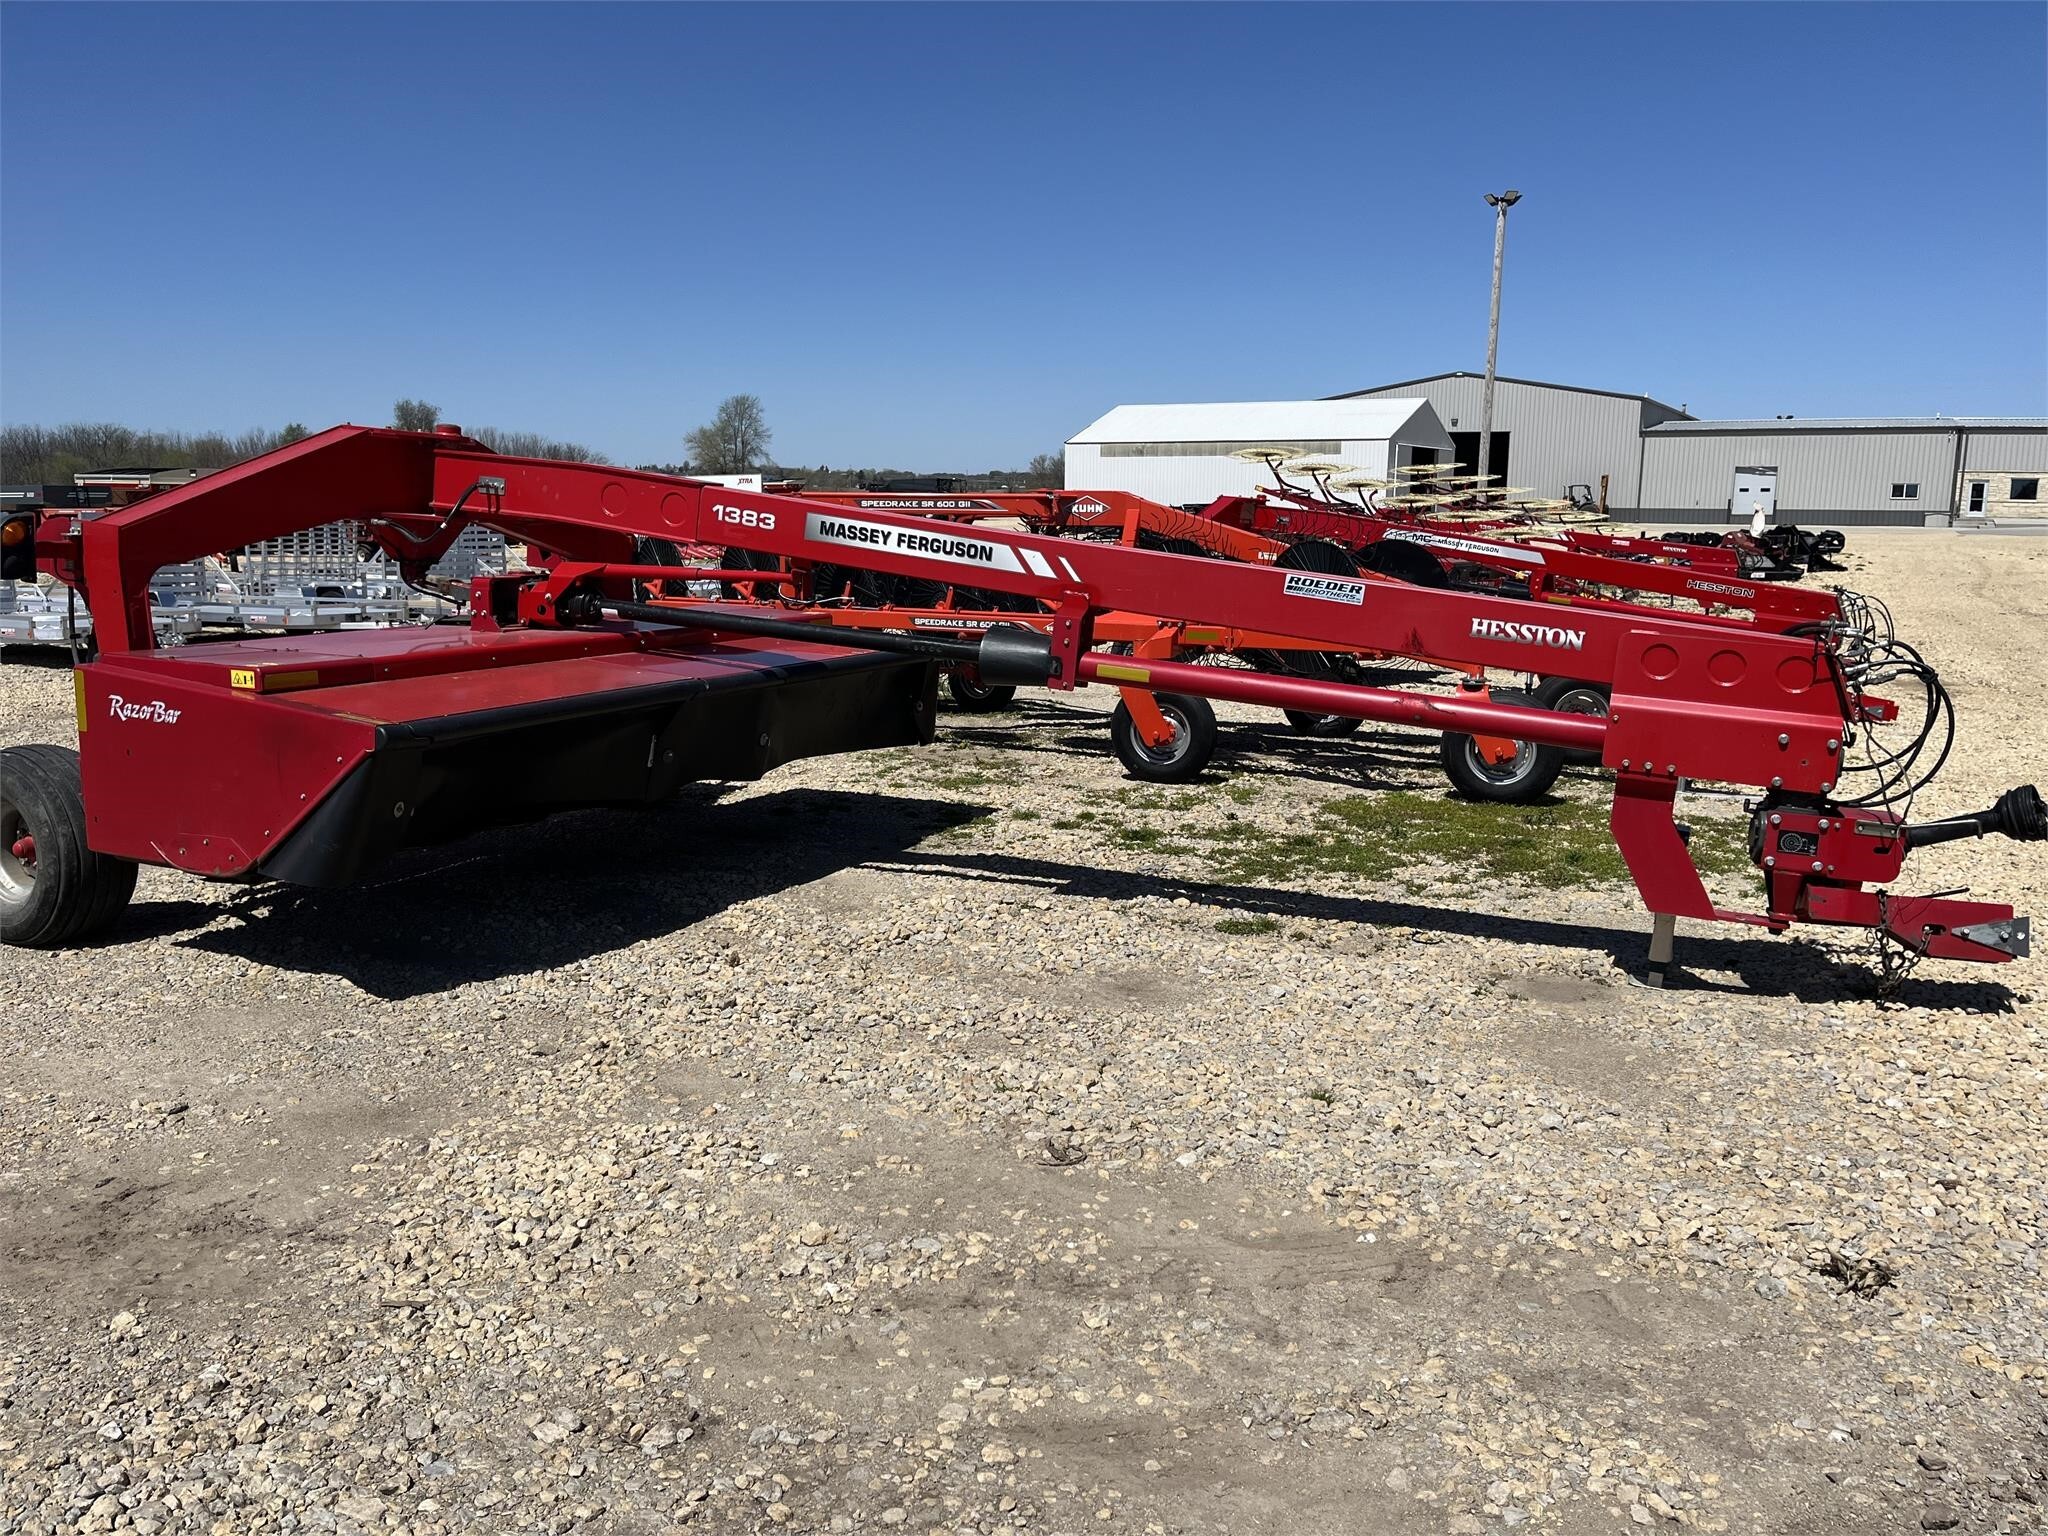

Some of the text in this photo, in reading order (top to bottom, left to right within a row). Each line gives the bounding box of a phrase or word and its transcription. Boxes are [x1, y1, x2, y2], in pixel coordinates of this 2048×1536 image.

[861, 500, 919, 508] SPEEDRAKE
[1071, 504, 1103, 513] KUHN
[712, 504, 776, 530] 1383
[819, 520, 993, 562] MASSEY FERGUSON
[1437, 539, 1500, 553] MASSEY FERGUSON
[1287, 575, 1363, 594] ROEDER
[1304, 586, 1357, 600] BROTHERS
[1686, 579, 1756, 599] HESSTON
[914, 618, 964, 627] SPEEDRAKE
[966, 620, 978, 628] SR
[1469, 617, 1586, 650] HESSTON
[107, 694, 182, 724] RazorBar
